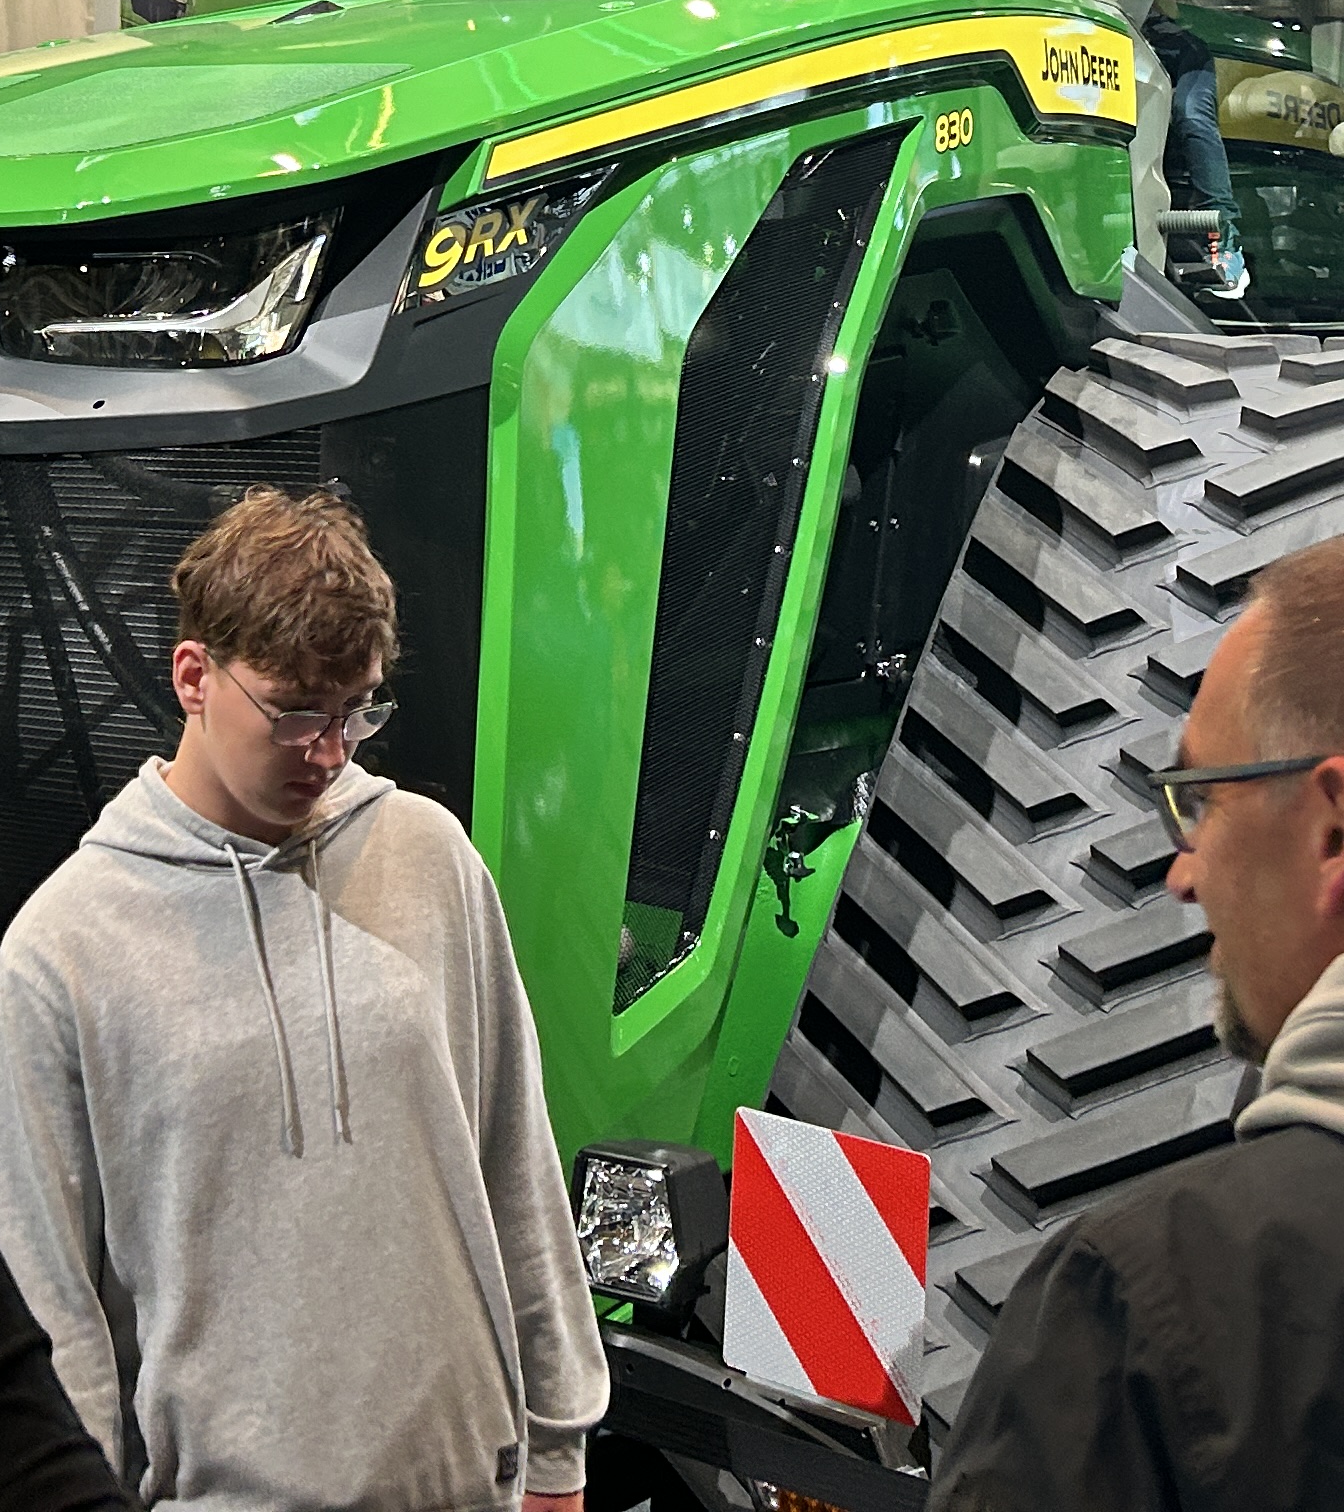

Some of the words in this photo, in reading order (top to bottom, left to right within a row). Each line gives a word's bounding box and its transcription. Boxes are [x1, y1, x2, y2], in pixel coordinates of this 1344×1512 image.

[1041, 38, 1079, 84] JOHN
[1080, 44, 1121, 91] DEERE
[935, 106, 974, 154] 830
[418, 192, 549, 290] 9RX
